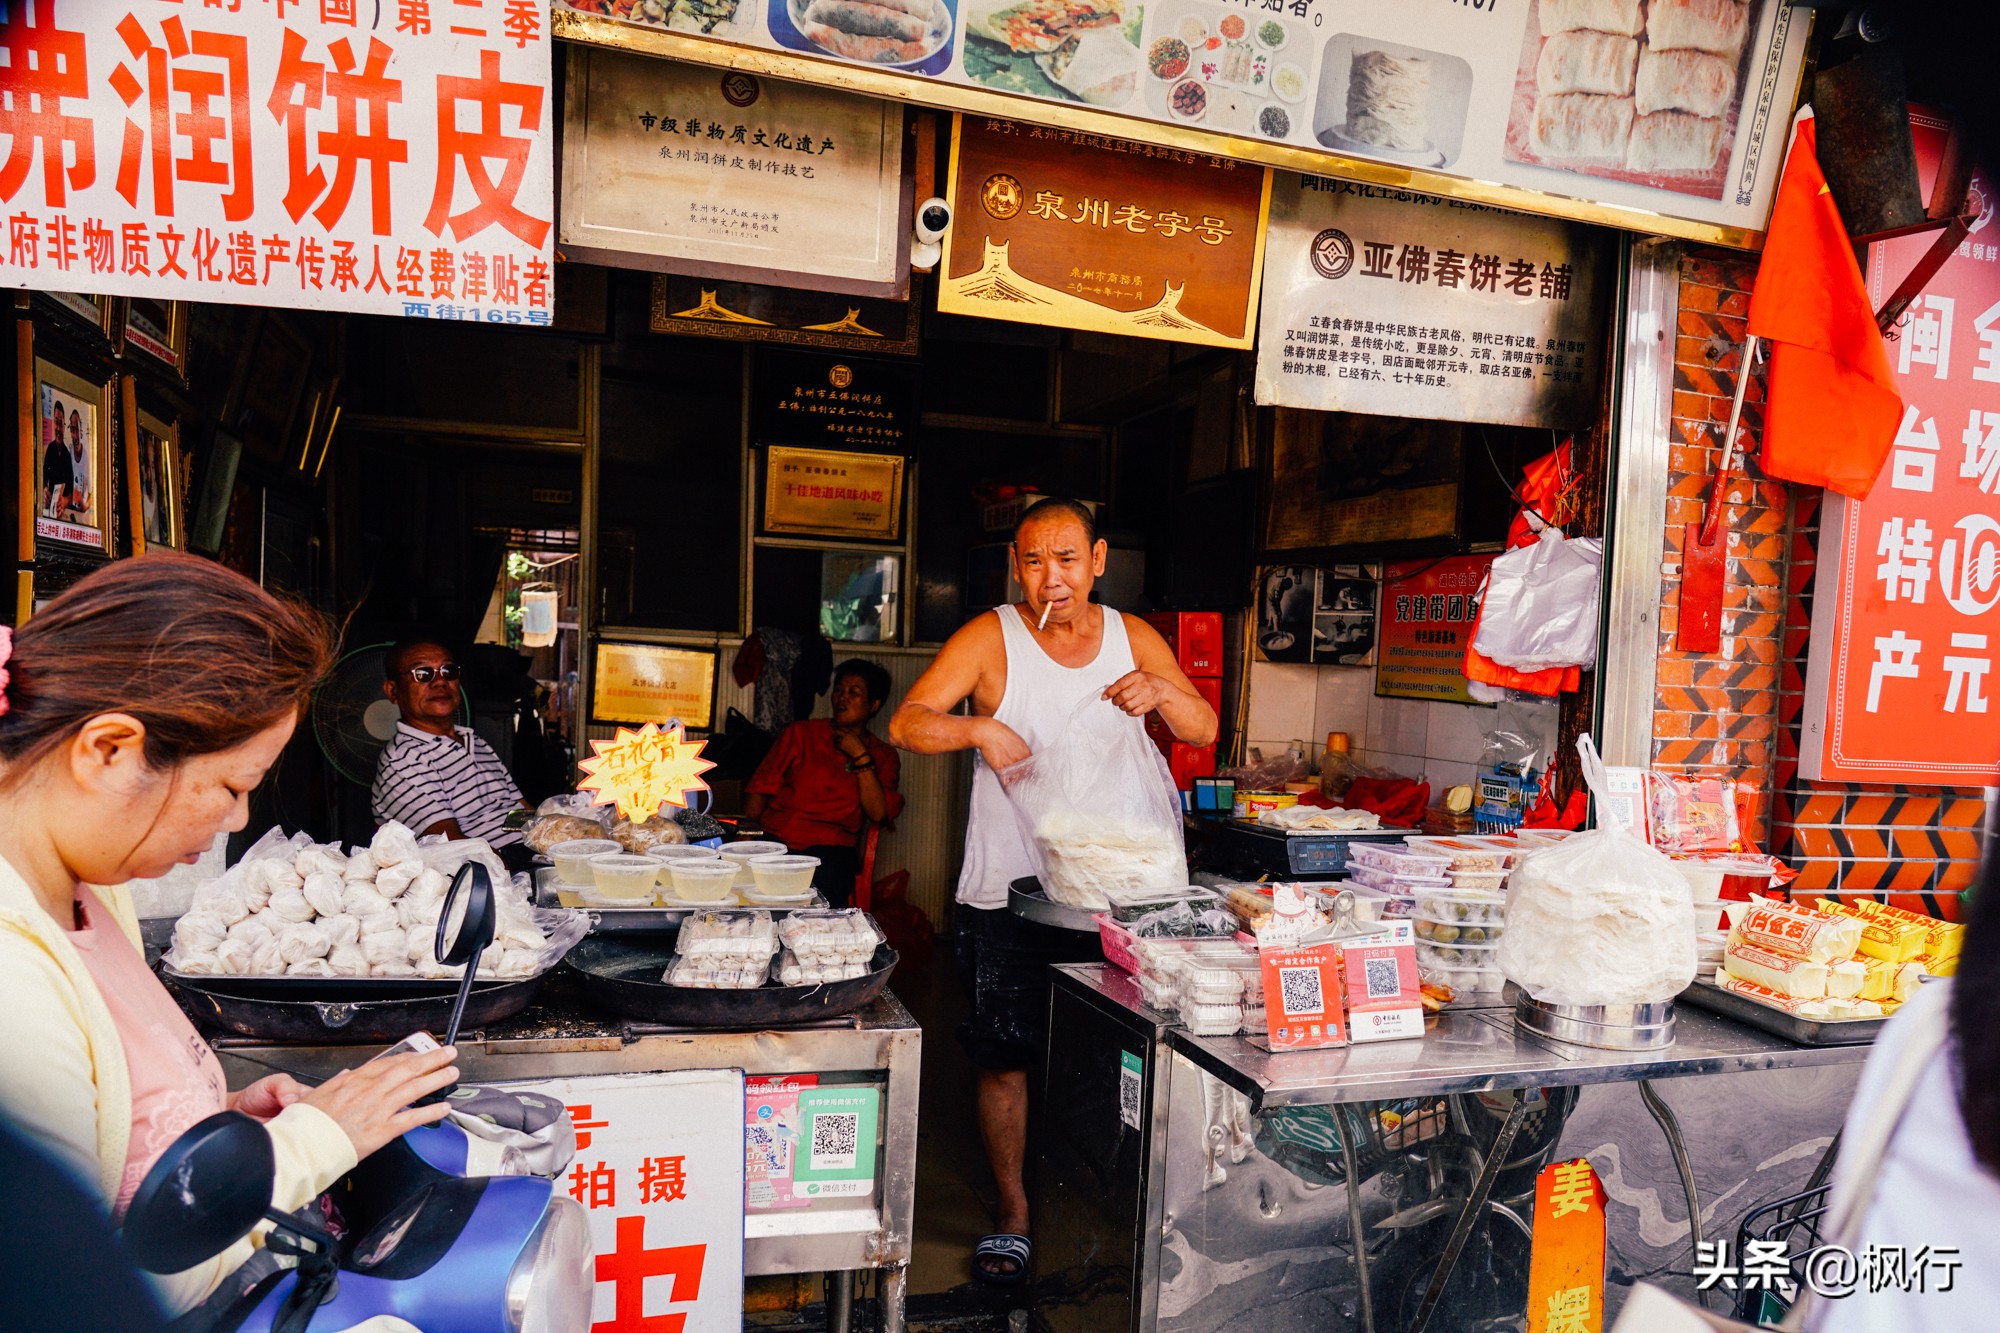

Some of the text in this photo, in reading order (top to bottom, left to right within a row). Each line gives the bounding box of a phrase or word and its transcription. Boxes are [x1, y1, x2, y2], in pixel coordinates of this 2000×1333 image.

[638, 110, 836, 156] 市级非物质文化遗产
[658, 145, 816, 179] 泉州润饼皮制作技艺
[1027, 190, 1234, 246] 泉州老字号
[0, 210, 550, 308] 府非物质文化遗产传承人经费津贴者
[401, 301, 553, 327] 西街165号
[1364, 948, 1397, 959] 扫码付款
[568, 1155, 688, 1209] 拍摄
[822, 1184, 857, 1193] 微信支付
